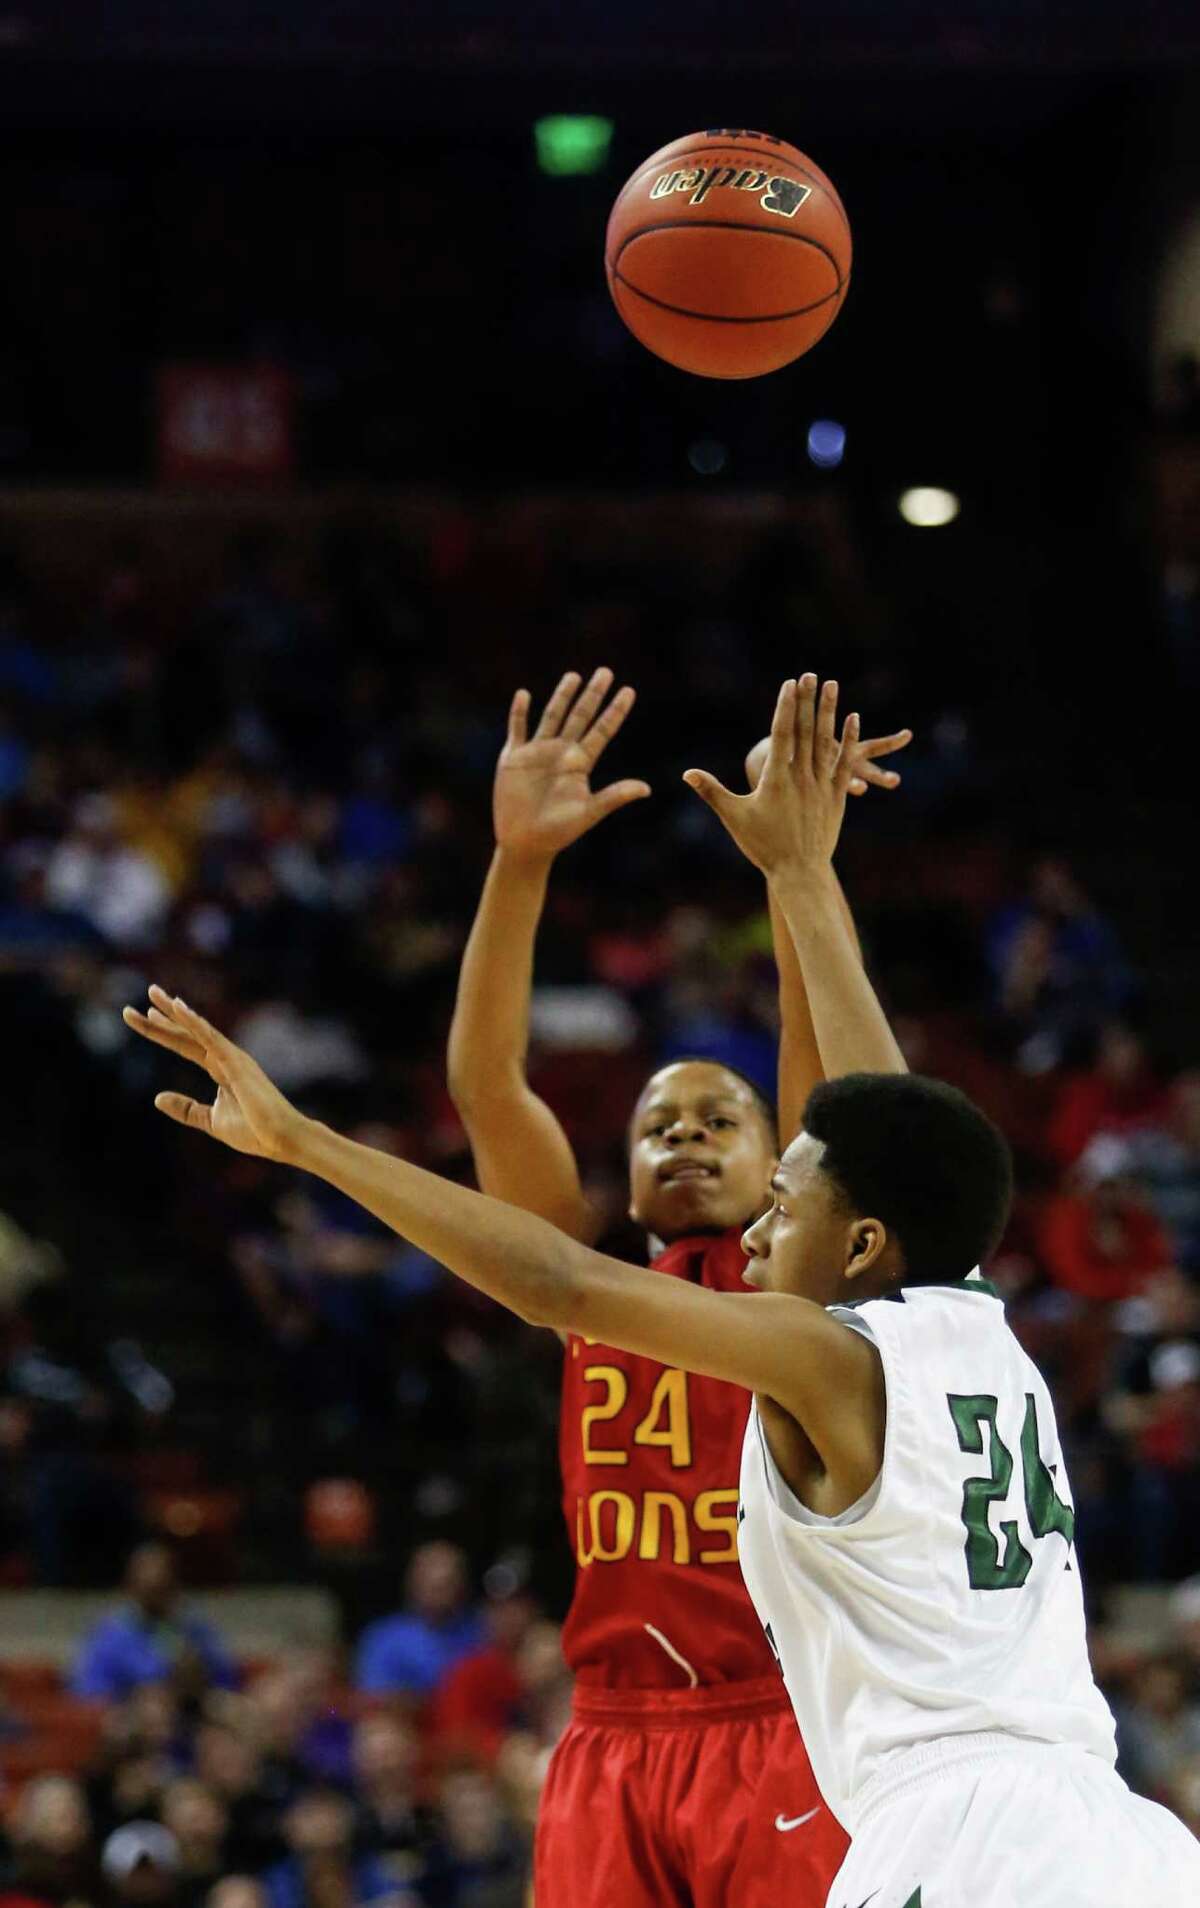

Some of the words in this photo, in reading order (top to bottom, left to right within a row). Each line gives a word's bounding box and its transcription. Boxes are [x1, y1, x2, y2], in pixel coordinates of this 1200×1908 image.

[649, 166, 812, 218] Baden
[581, 1366, 691, 1467] 24
[946, 1391, 1075, 1591] 24
